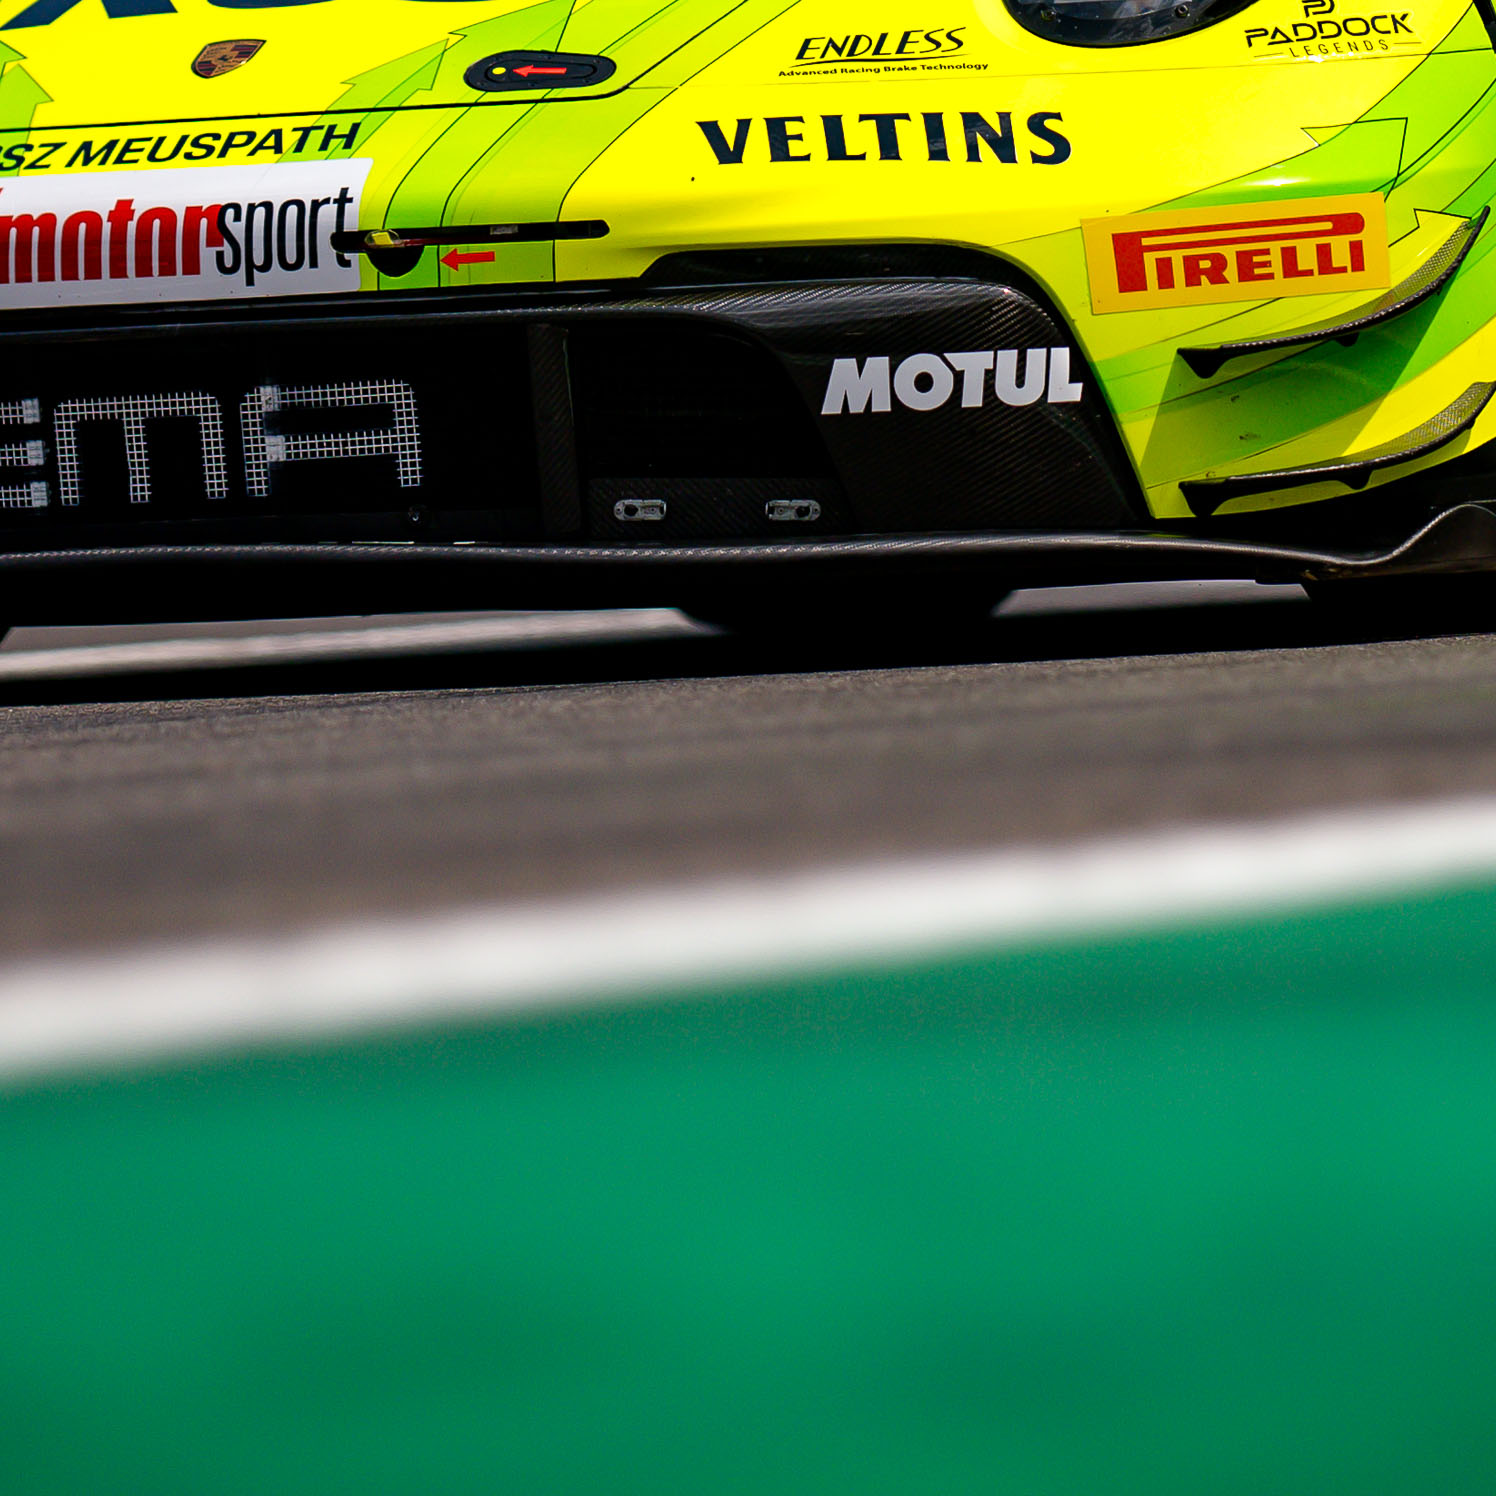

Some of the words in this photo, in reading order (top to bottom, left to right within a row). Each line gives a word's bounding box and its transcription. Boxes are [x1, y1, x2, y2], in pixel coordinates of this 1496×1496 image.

[795, 27, 967, 61] ENDLESS
[1244, 13, 1413, 48] PADDOCK
[1289, 39, 1389, 58] LEGENDS
[778, 67, 838, 77] Advanced
[883, 64, 918, 73] Brake
[920, 62, 989, 71] Technology
[65, 122, 361, 167] MEUSPATH
[696, 111, 1071, 165] VELTINS
[1111, 212, 1365, 293] PIRELLI
[821, 347, 1083, 415] MOTUL
